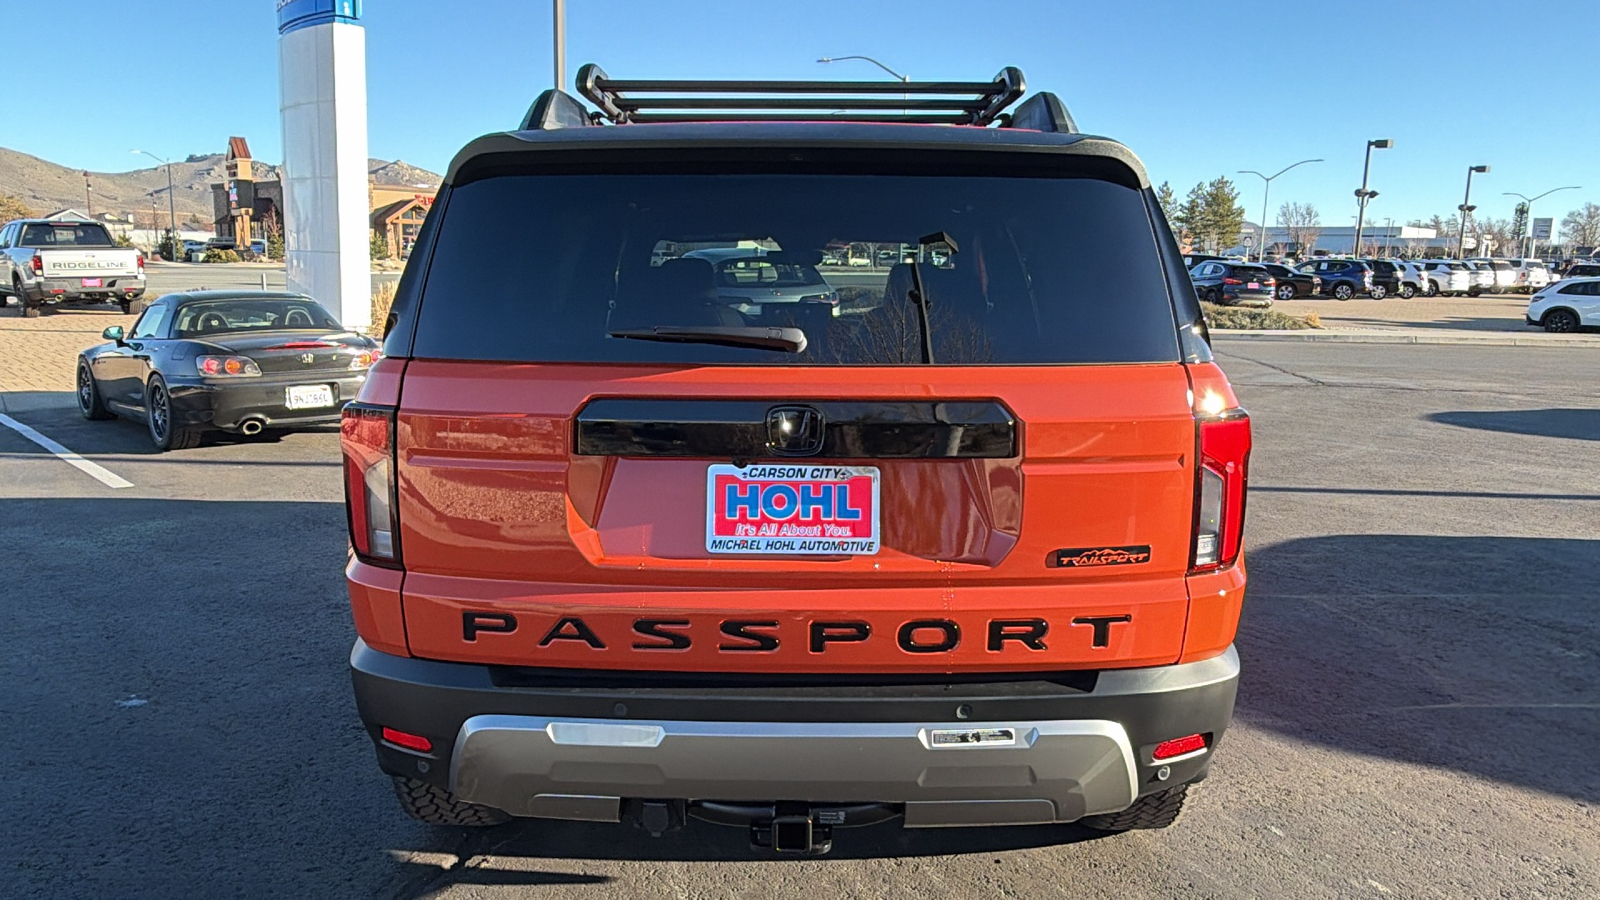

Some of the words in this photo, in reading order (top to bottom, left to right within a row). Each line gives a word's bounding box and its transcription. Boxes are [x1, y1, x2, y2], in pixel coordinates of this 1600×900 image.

[52, 261, 129, 269] RIDGELINE
[748, 467, 806, 479] CARSON
[810, 468, 841, 479] CITY
[725, 483, 862, 520] HOHL
[735, 523, 756, 536] It's
[758, 523, 777, 536] All
[779, 523, 821, 536] About
[823, 523, 852, 536] You.
[710, 539, 762, 551] MICHAEL
[765, 540, 796, 551] HOHL
[799, 540, 876, 552] AUTOMOTIVE
[1060, 553, 1149, 566] TRAILSPORT
[461, 611, 1132, 655] PASSPORT
